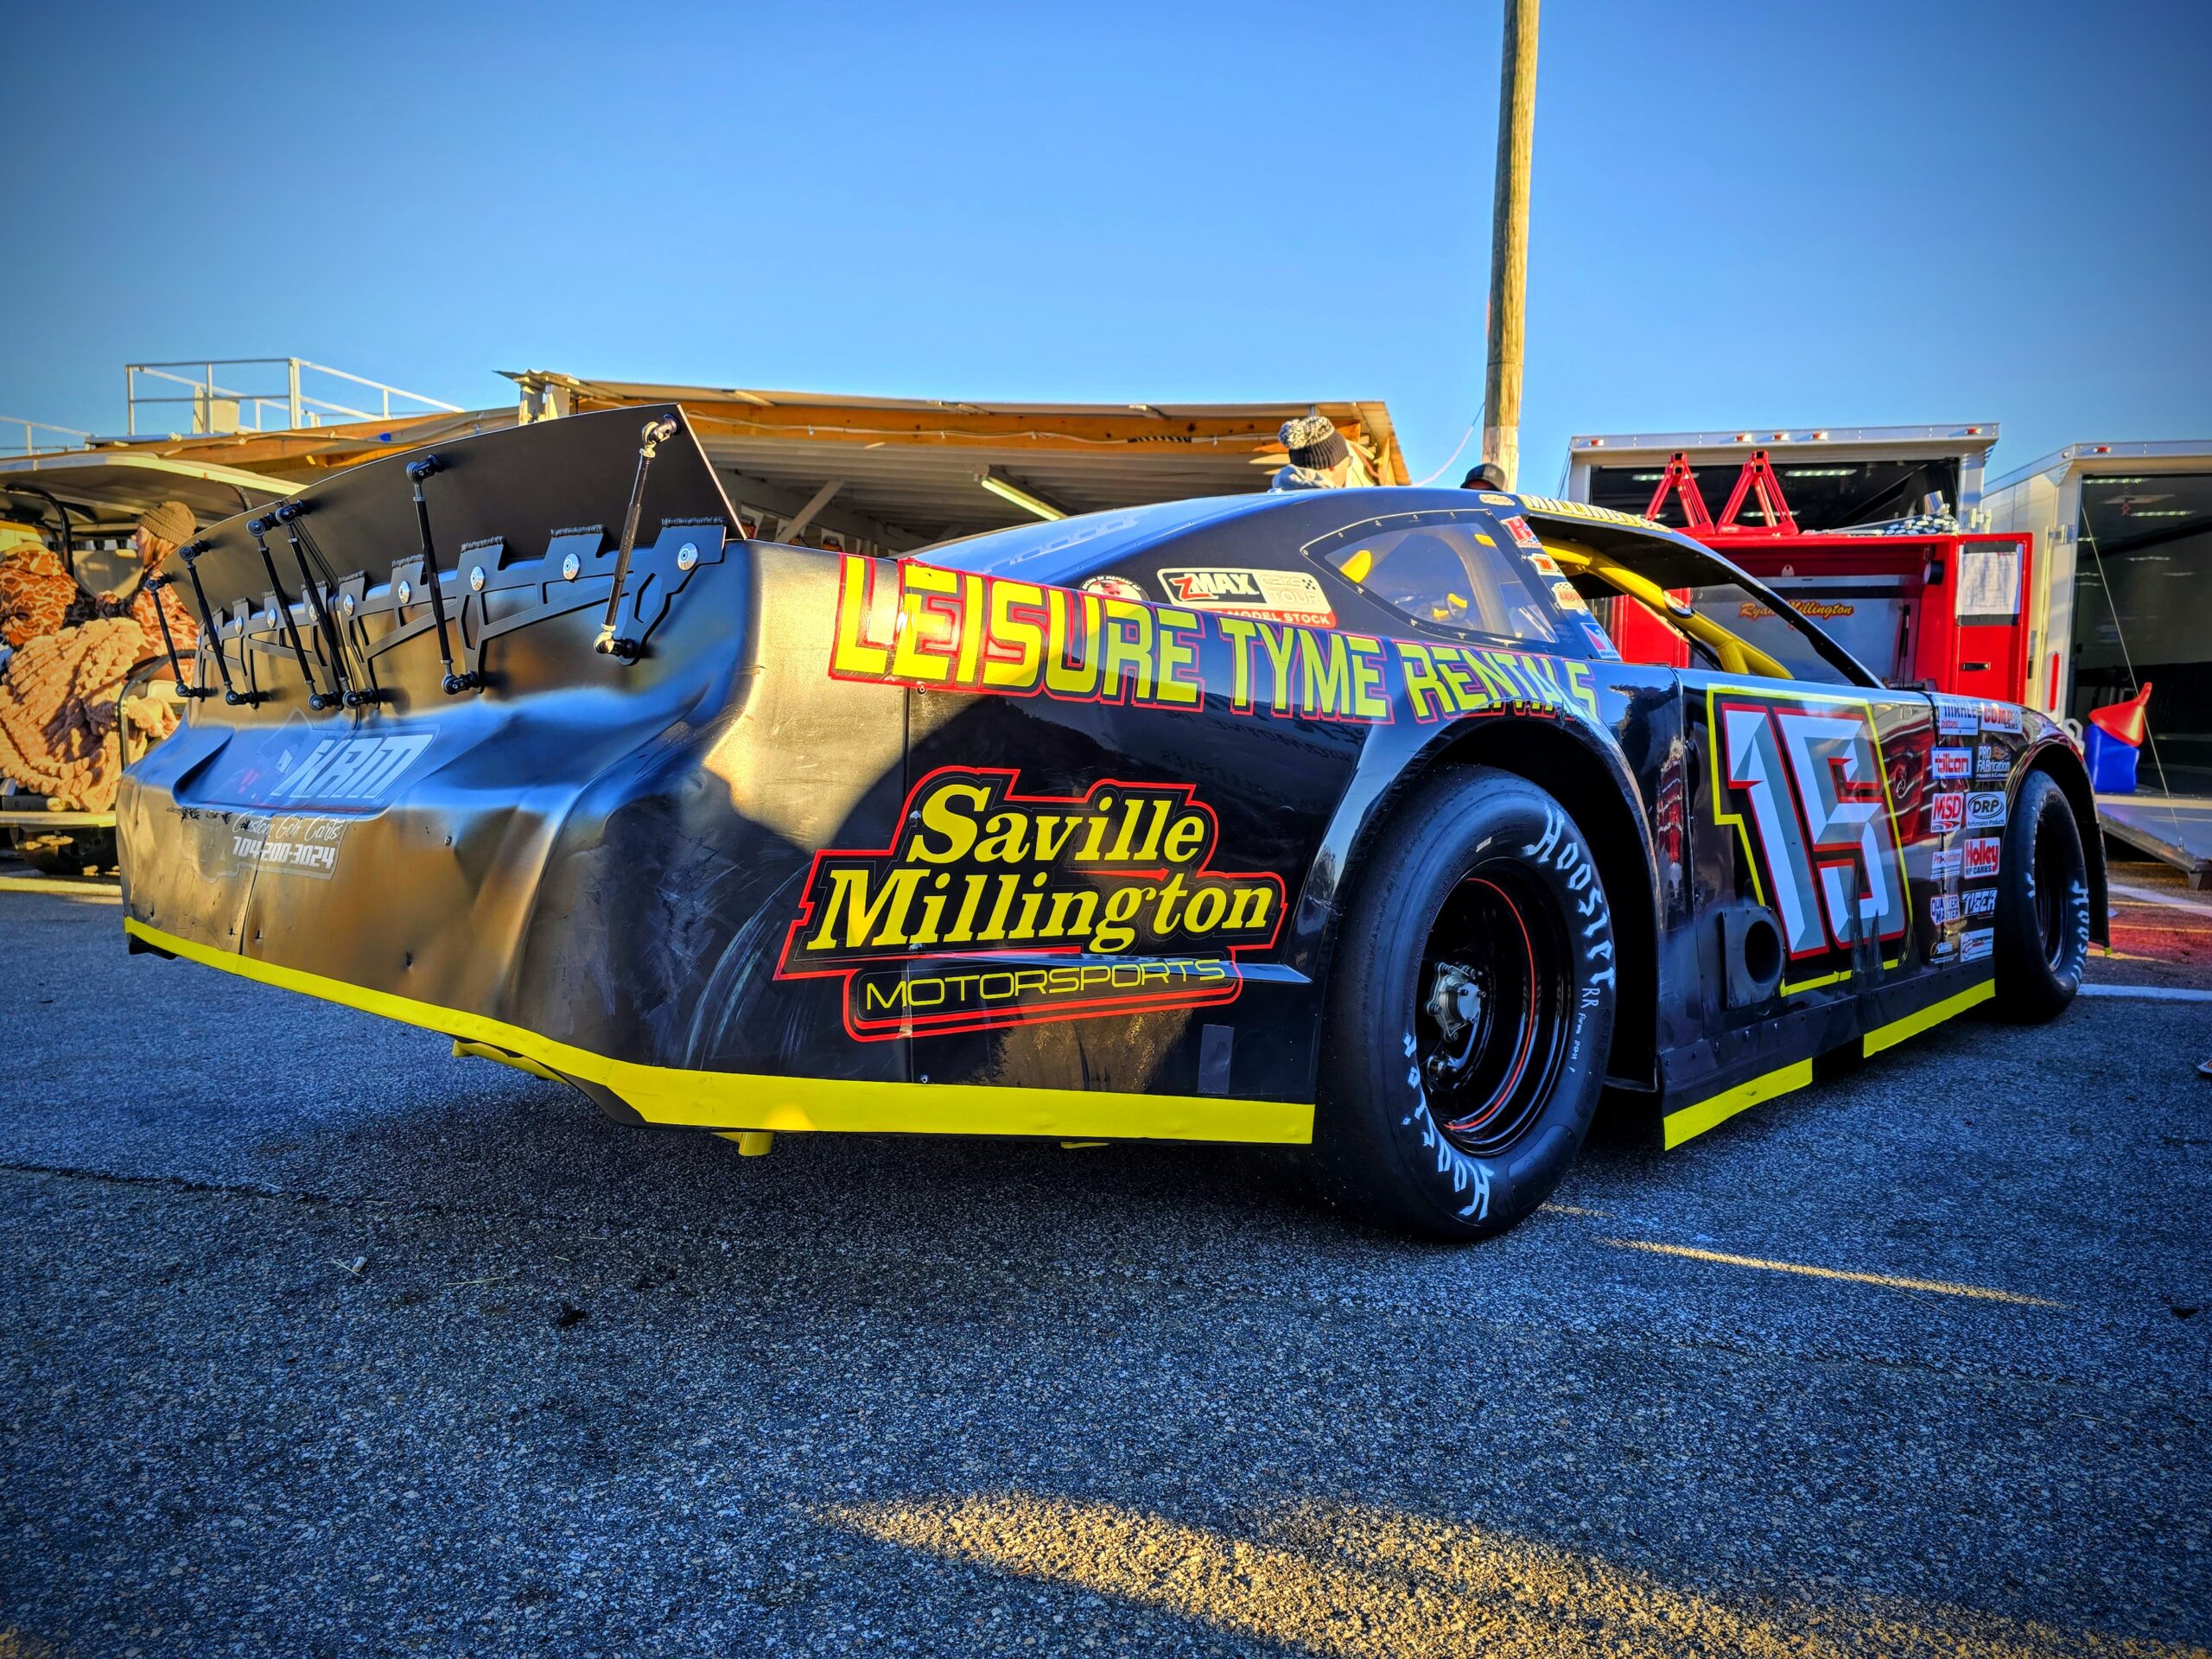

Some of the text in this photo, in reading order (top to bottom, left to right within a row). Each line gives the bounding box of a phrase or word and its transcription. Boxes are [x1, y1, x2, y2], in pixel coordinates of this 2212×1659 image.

[1269, 588, 1322, 605] TOUR
[1283, 613, 1331, 625] STOCK
[829, 552, 1602, 726] LEISURE TYME RENTALS
[1943, 702, 1977, 718] MAHLE
[1983, 704, 2012, 724] COMP
[1935, 753, 1969, 773] tilton
[1978, 746, 1992, 760] PRO
[1976, 760, 2011, 773] FABrication
[1933, 796, 1962, 819] MSD
[1973, 799, 1999, 813] DRP
[232, 810, 275, 838] Custom
[906, 783, 1205, 864] Saville
[1721, 702, 1907, 961] 15
[232, 836, 336, 869] 704-200-3024
[1964, 840, 1999, 872] Holley
[1965, 867, 1973, 875] HP
[1973, 865, 1993, 874] CARBS
[1522, 800, 1618, 990] Hoosier
[806, 868, 1274, 952] Millington
[866, 958, 1228, 1012] MOTORSPORTS
[1581, 988, 1601, 1009] RR
